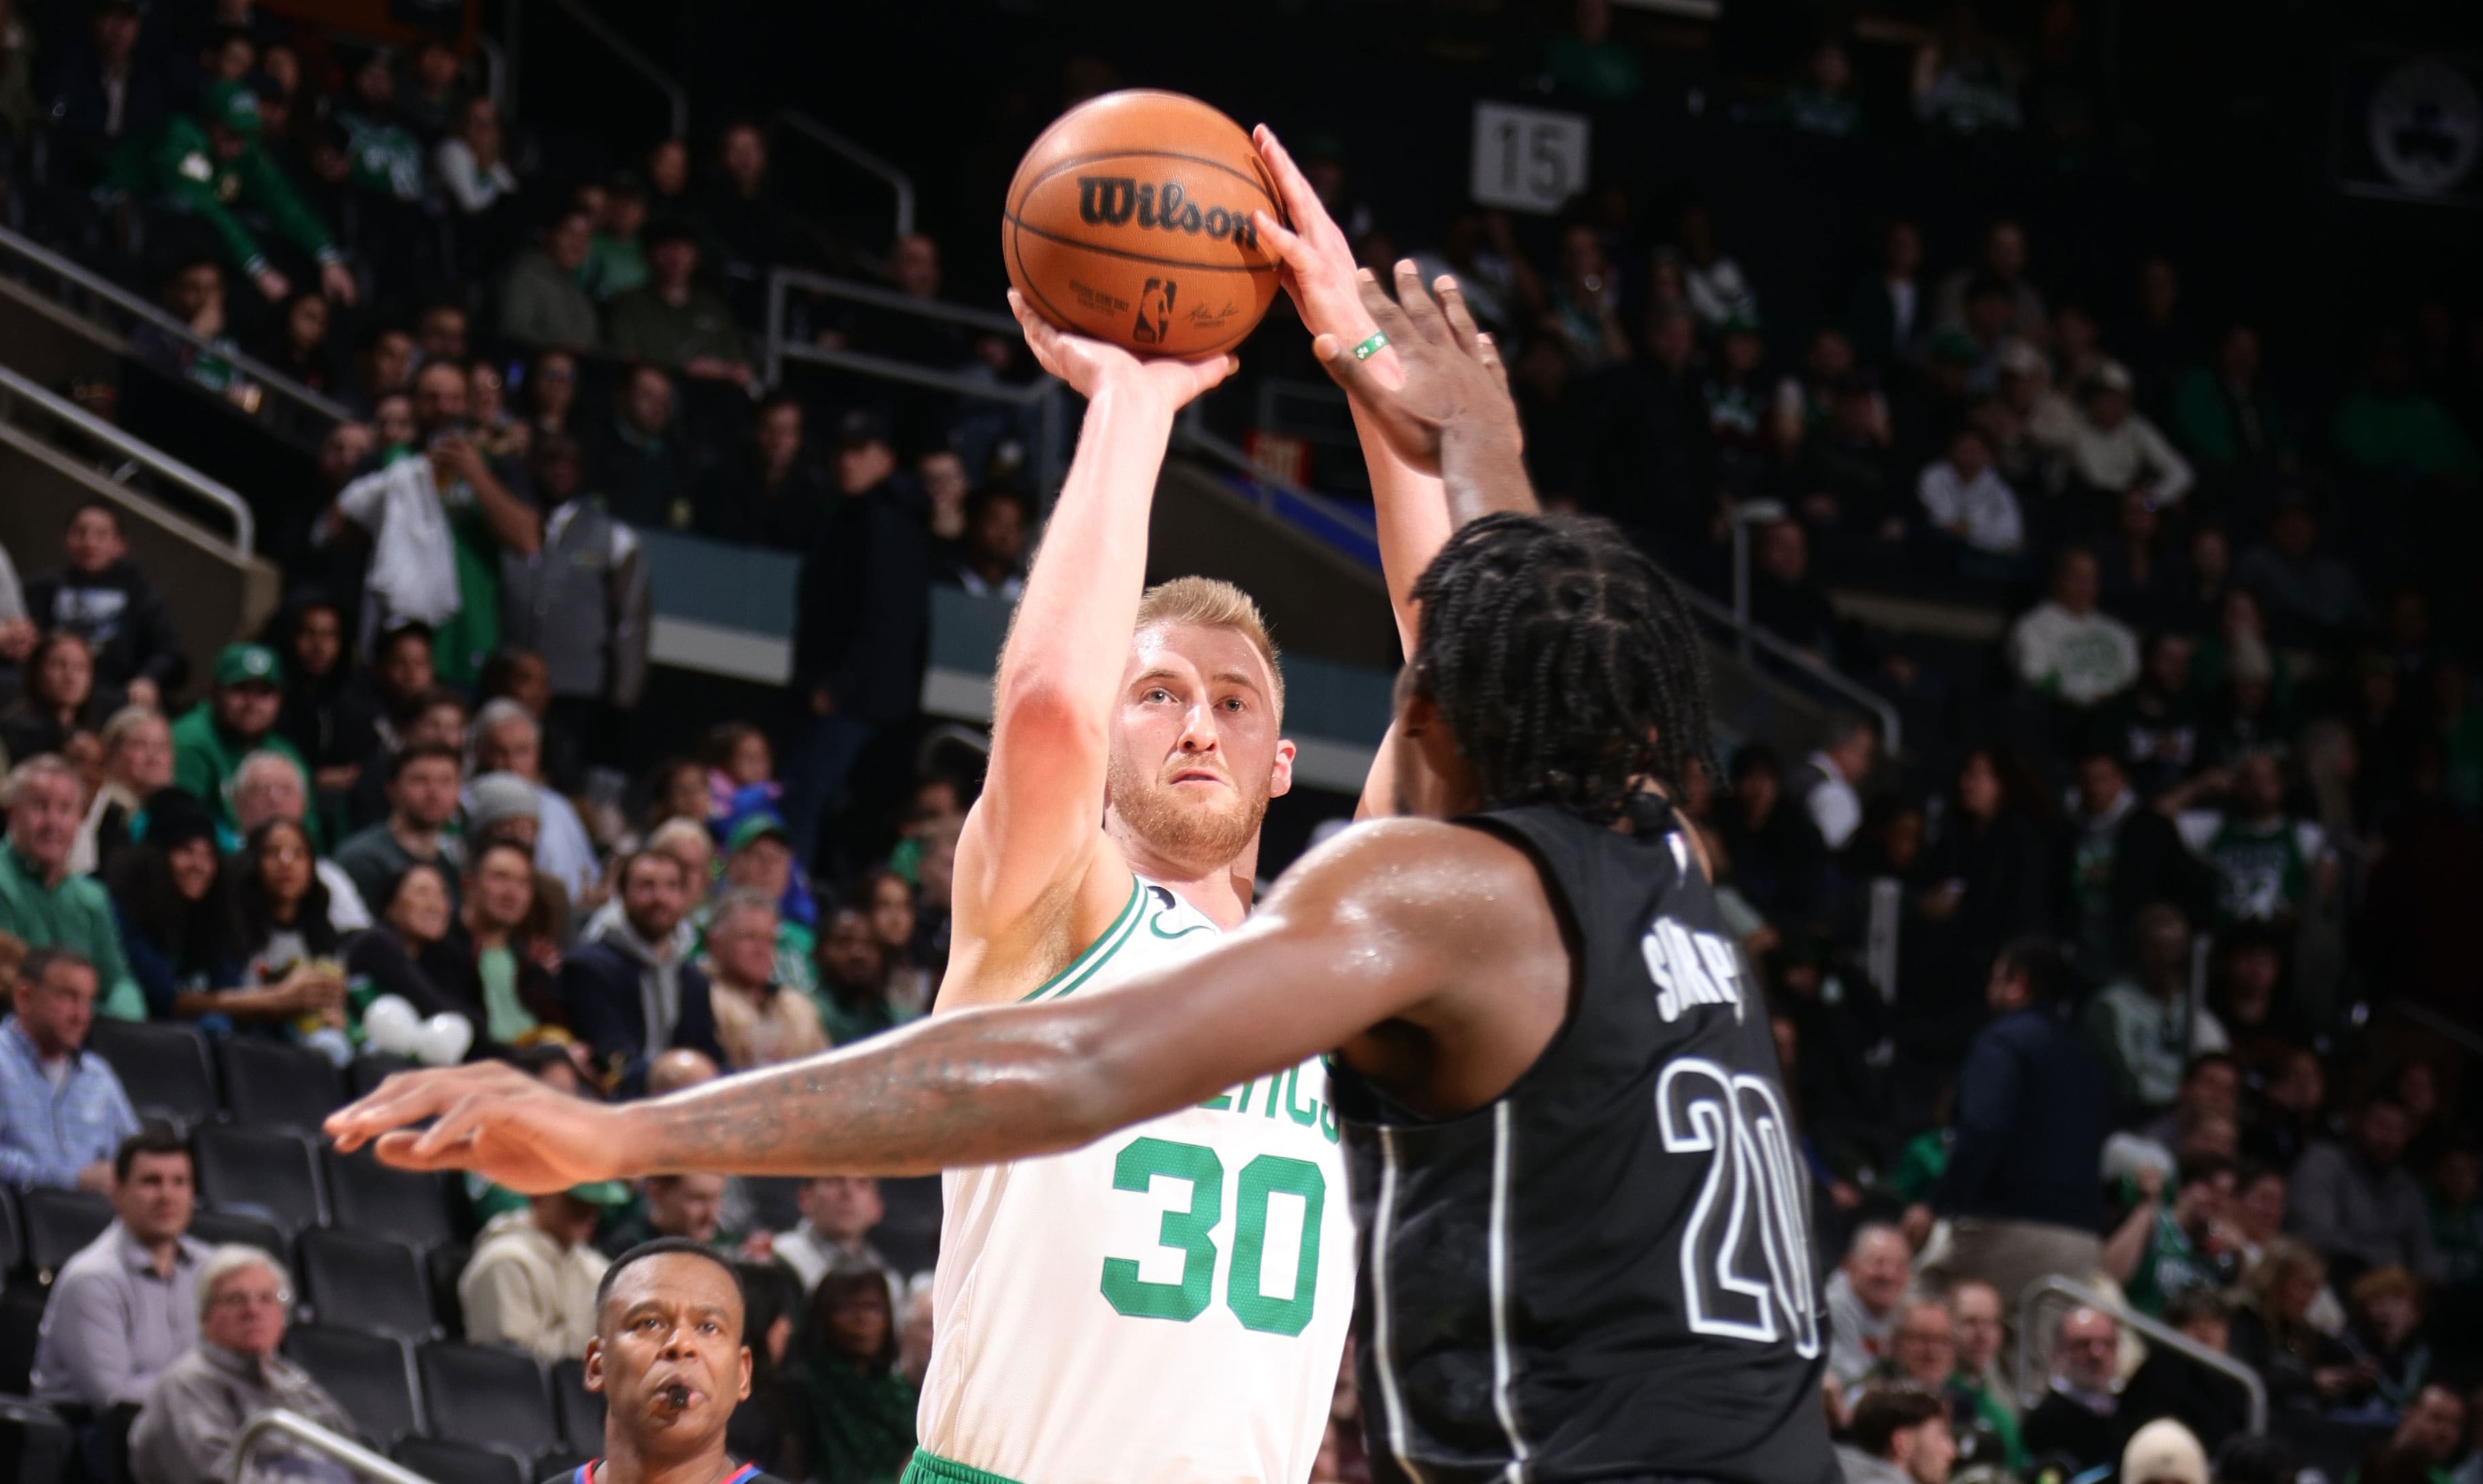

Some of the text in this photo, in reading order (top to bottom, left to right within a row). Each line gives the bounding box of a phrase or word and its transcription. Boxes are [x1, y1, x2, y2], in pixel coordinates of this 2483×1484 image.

[1078, 176, 1258, 250] Wilson
[1498, 120, 1567, 197] 15
[1101, 1136, 1326, 1337] 30
[1657, 1058, 1819, 1358] 20
